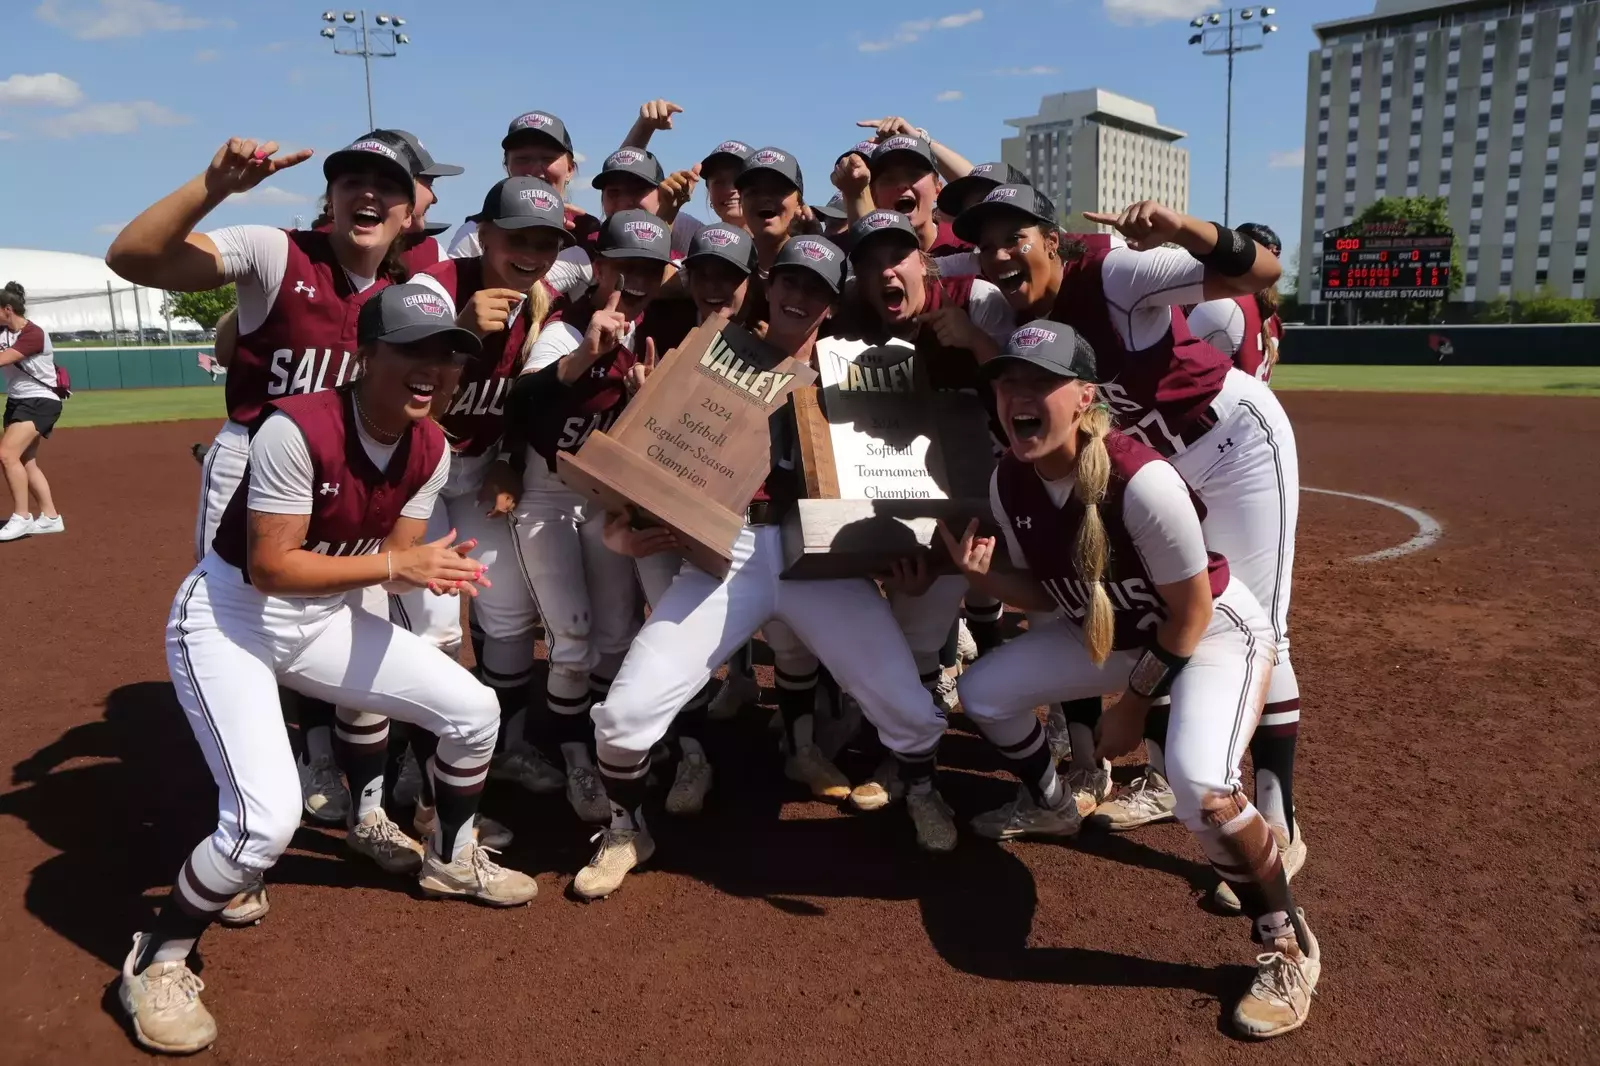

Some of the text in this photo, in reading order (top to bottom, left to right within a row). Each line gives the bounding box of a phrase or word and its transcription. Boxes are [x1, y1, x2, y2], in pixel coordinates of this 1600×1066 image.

[1336, 239, 1360, 249] 0:00
[405, 293, 449, 313] CHAMPIO
[1325, 289, 1444, 299] MARIAN KNEER STADIUM
[699, 329, 796, 404] VALLEY
[829, 350, 915, 393] VALLEY
[700, 397, 733, 422] 2024
[678, 412, 728, 447] Softball
[644, 416, 735, 479] Regular-Season
[866, 443, 914, 459] Softball
[646, 444, 708, 488] Champion
[854, 464, 933, 478] Tournament
[864, 485, 930, 499] Champion
